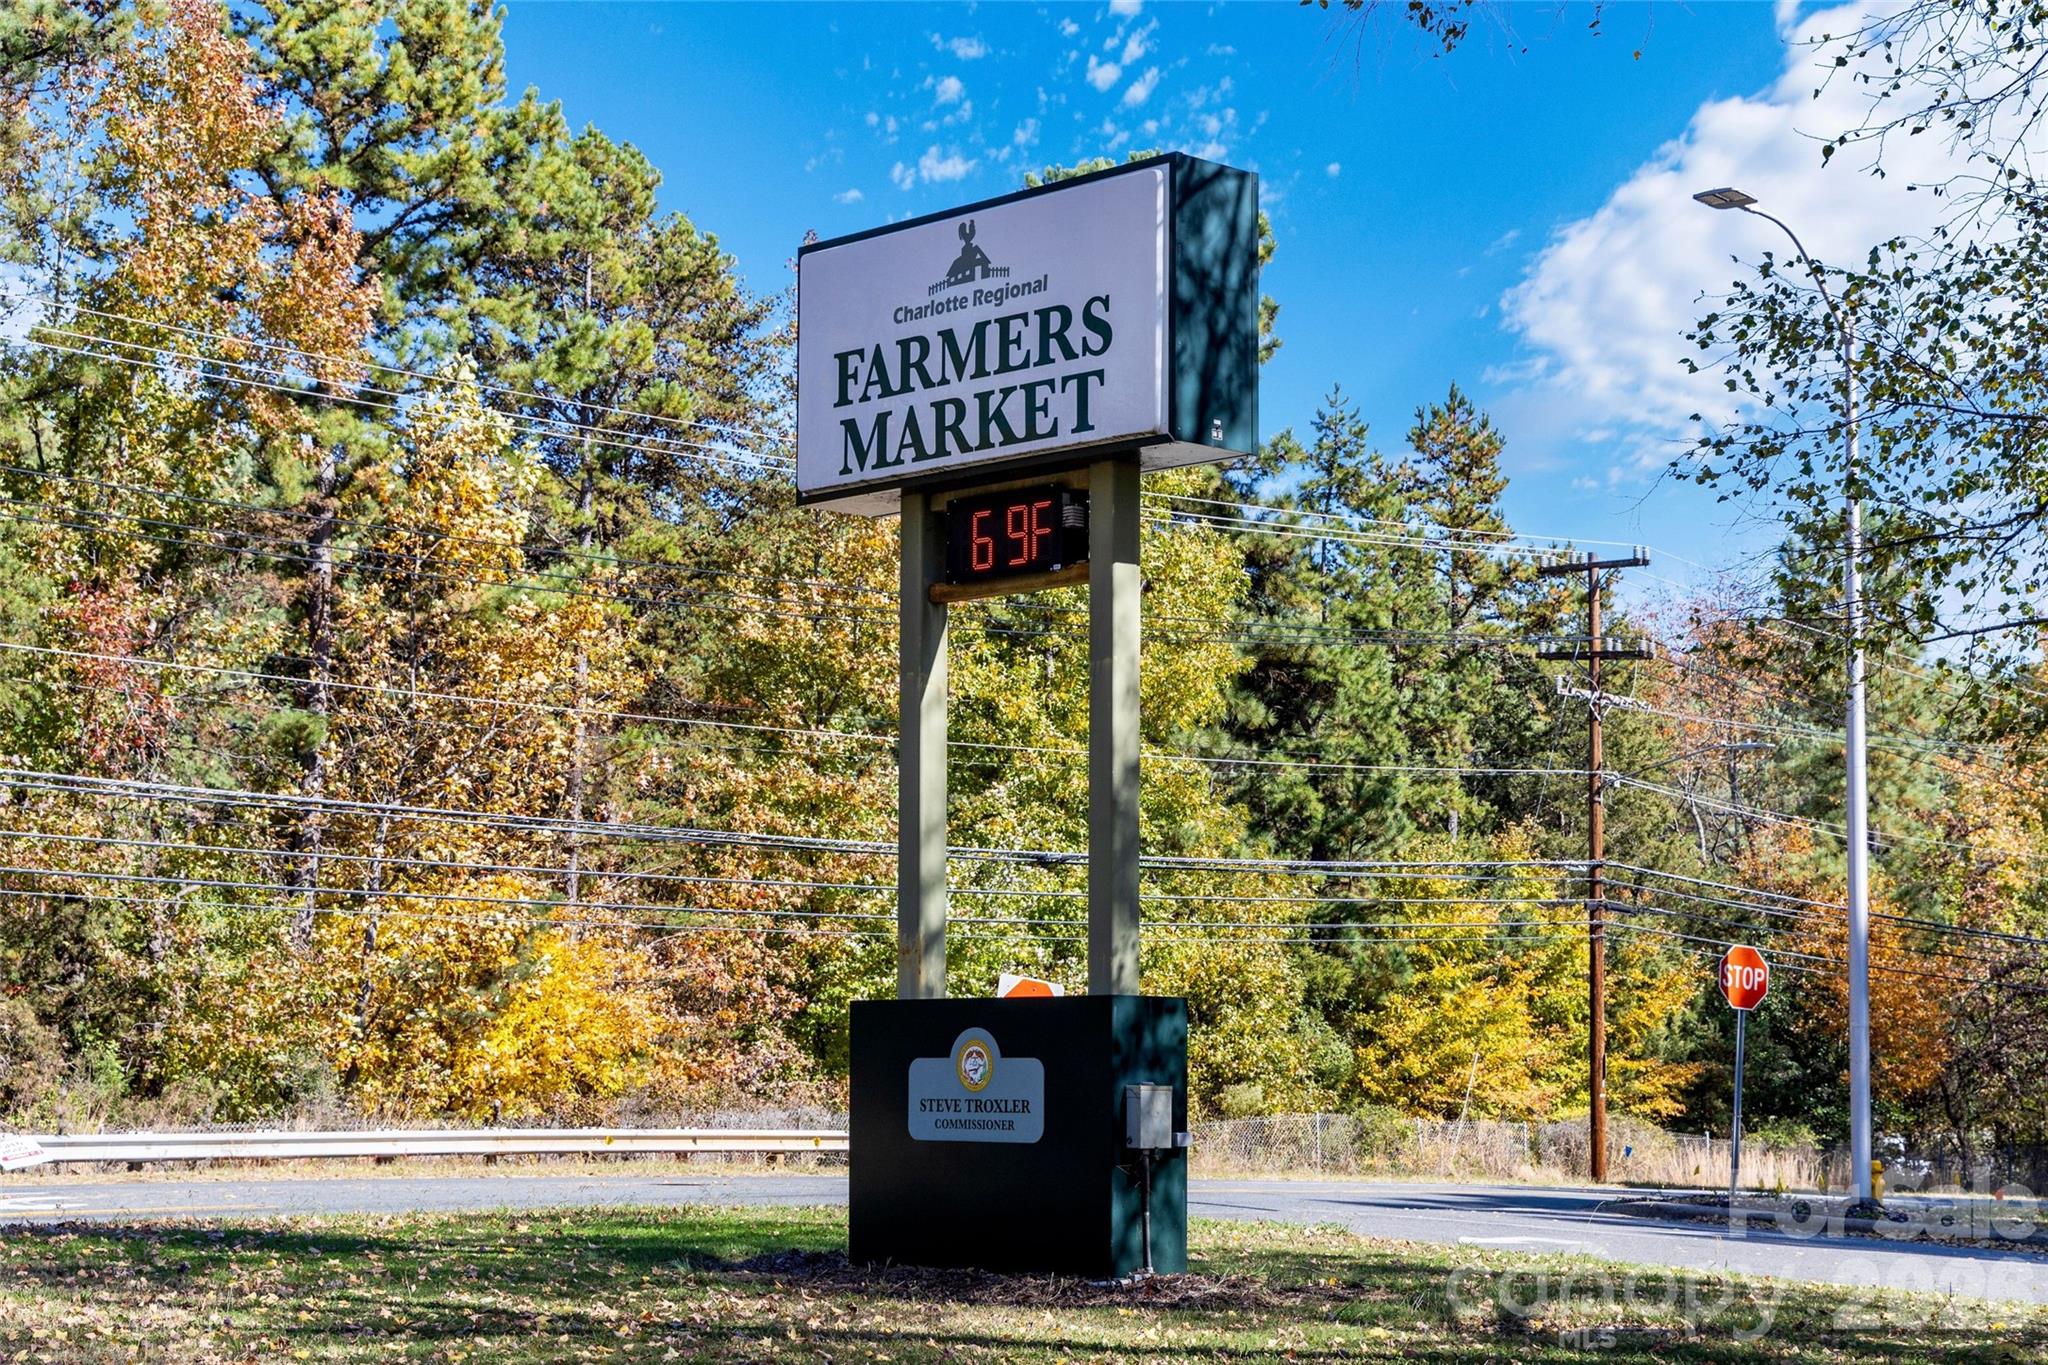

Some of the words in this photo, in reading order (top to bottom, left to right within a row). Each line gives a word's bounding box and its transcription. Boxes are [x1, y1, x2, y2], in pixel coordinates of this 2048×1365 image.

[893, 295, 968, 324] Charlotte
[973, 274, 1048, 307] Regional
[833, 295, 1113, 408] FARMERS
[838, 369, 1105, 476] MARKET
[1722, 963, 1765, 991] STOP
[919, 1098, 962, 1113] STEVE
[964, 1098, 1031, 1114] TROXLER
[934, 1118, 1015, 1131] COMMISSIONER
